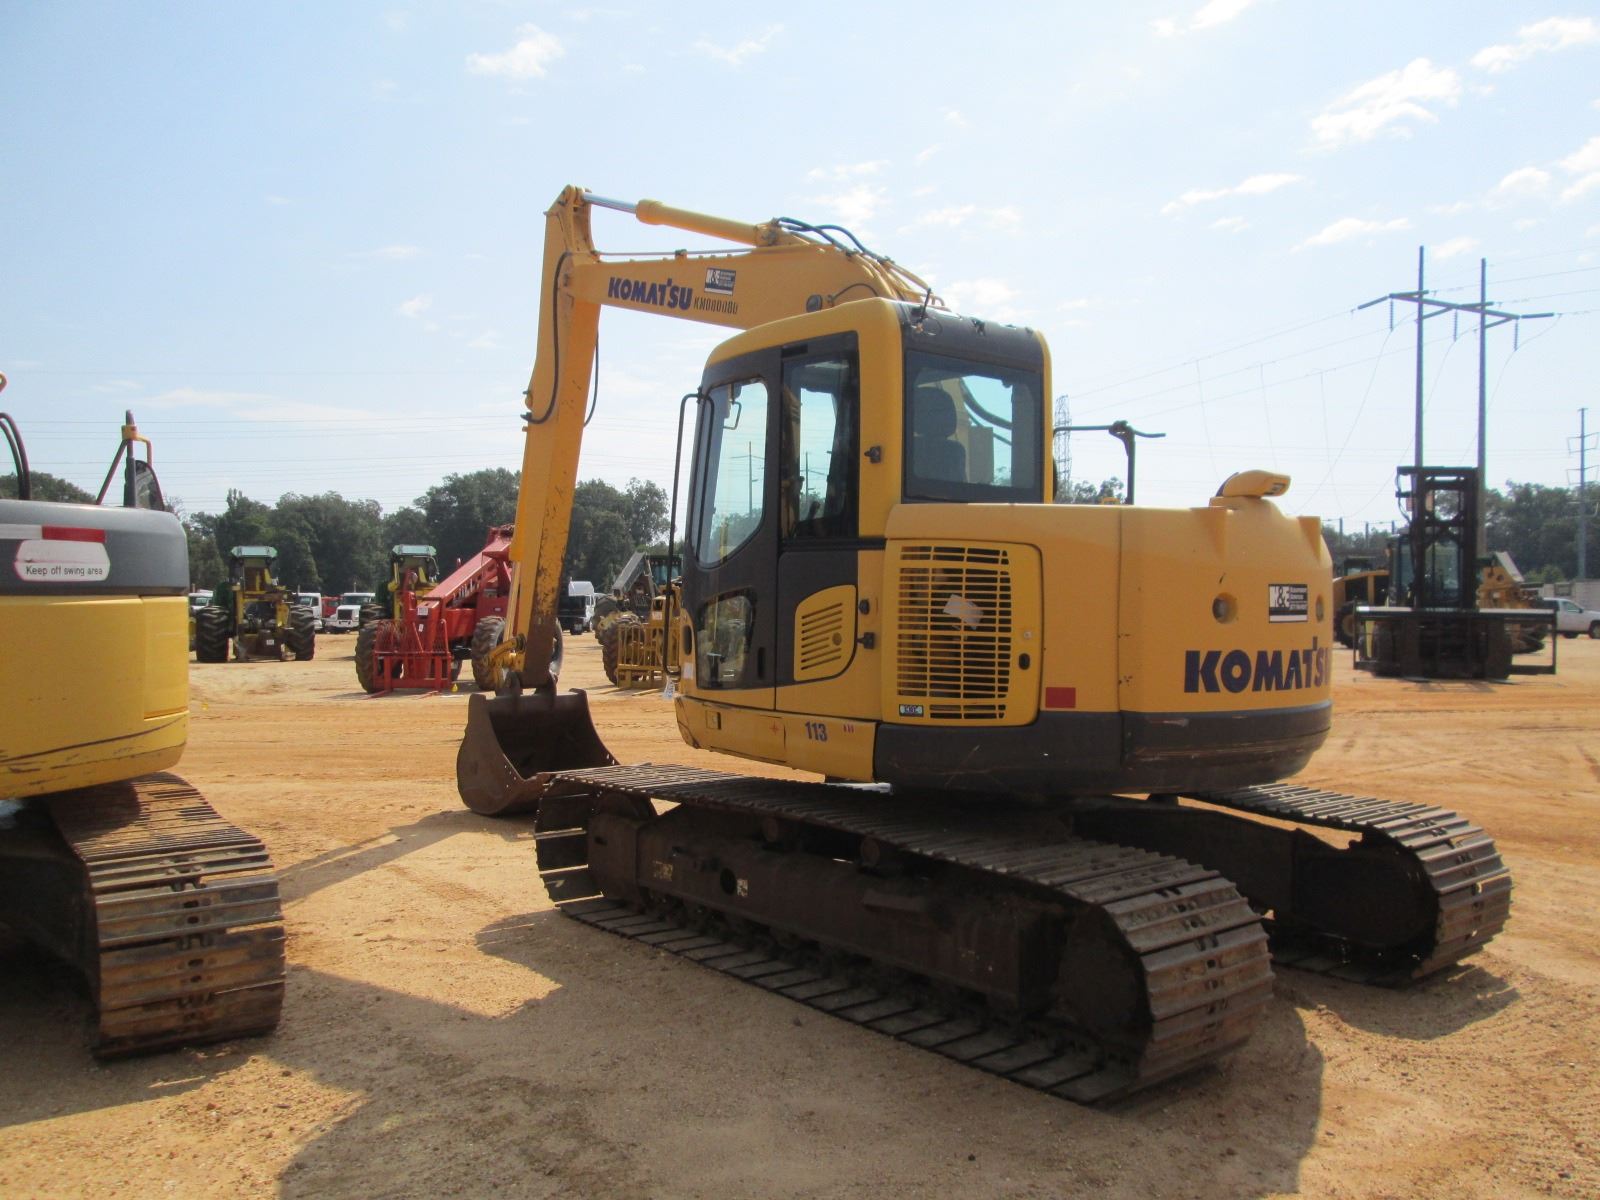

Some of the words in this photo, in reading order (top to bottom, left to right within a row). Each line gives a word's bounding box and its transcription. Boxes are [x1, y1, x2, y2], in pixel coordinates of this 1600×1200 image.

[608, 277, 693, 310] KOMATSU
[26, 565, 48, 576] Keep
[51, 565, 62, 575] off
[64, 566, 84, 576] swing
[87, 567, 103, 575] area
[805, 720, 828, 742] 113
